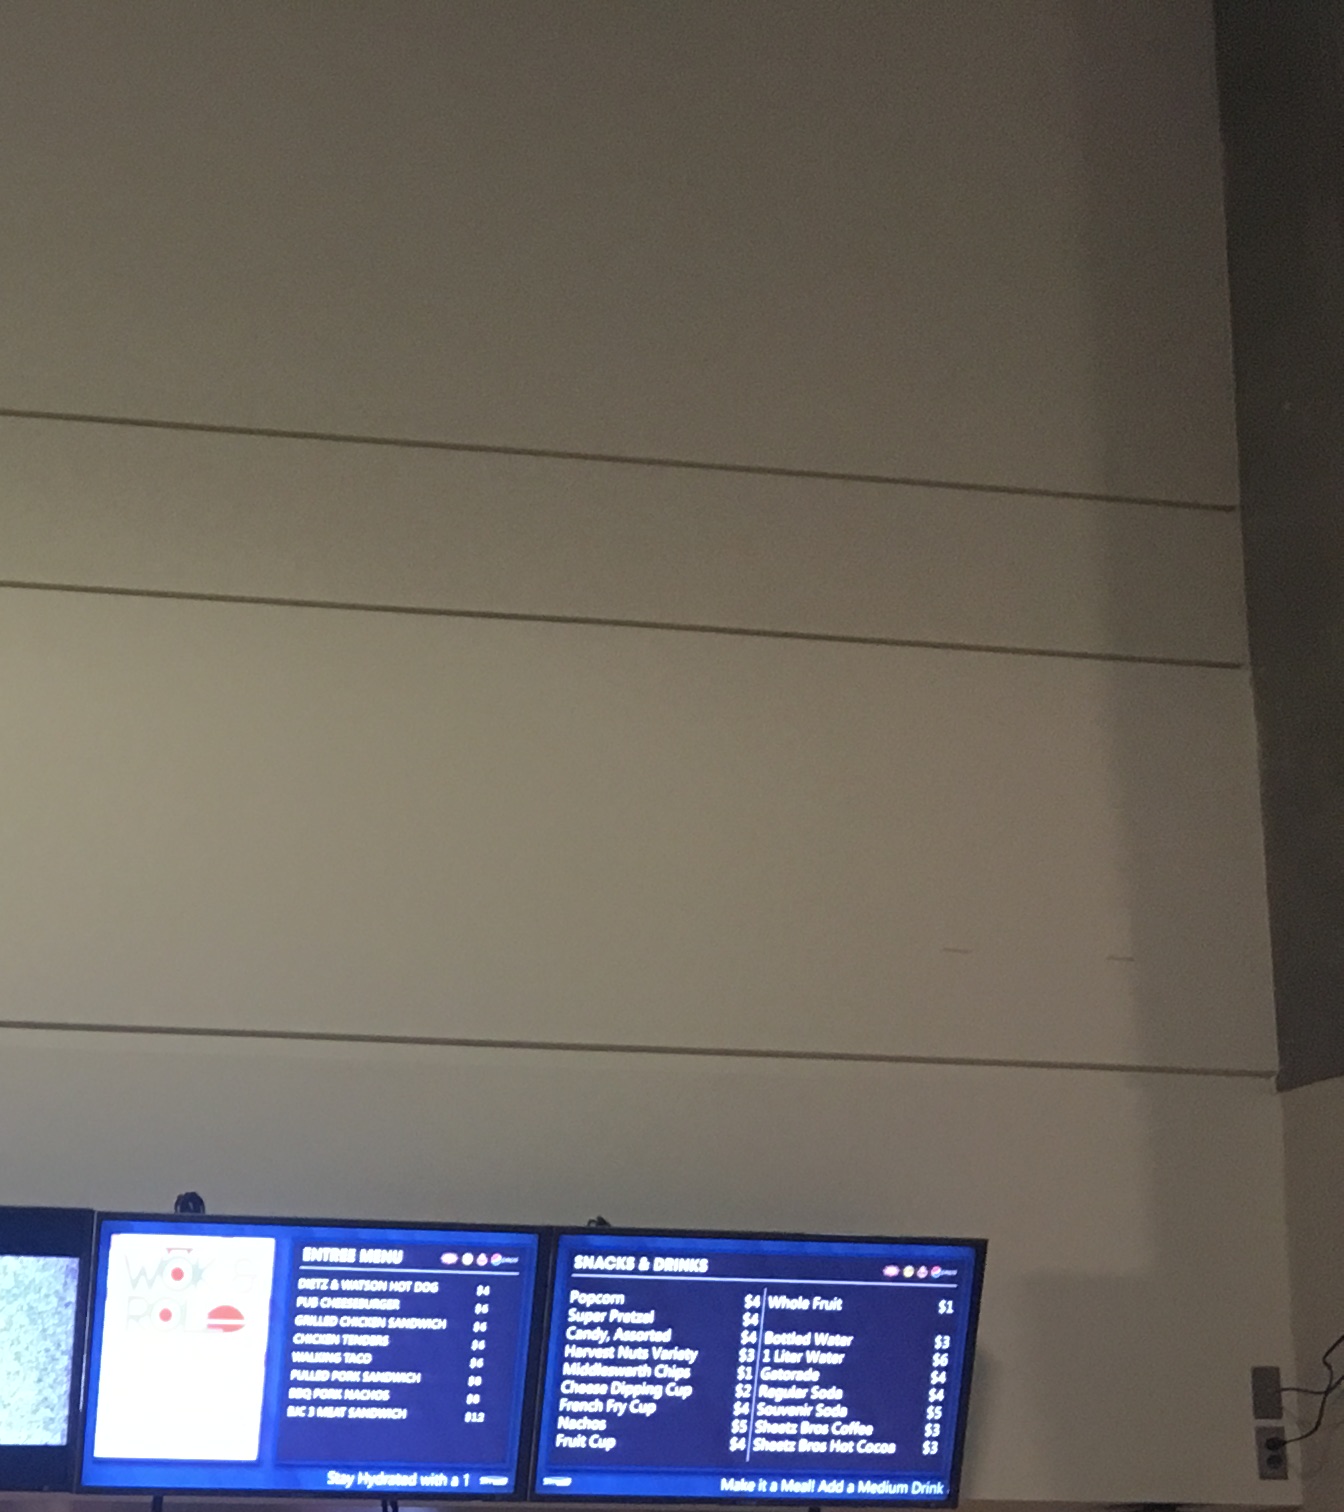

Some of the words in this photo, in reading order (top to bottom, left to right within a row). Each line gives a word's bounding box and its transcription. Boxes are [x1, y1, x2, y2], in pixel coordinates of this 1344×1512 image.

[303, 1247, 356, 1263] ENTREE
[359, 1249, 403, 1264] MENU
[574, 1255, 635, 1270] SNACKS
[638, 1257, 650, 1271] &
[653, 1257, 708, 1272] DRINKS
